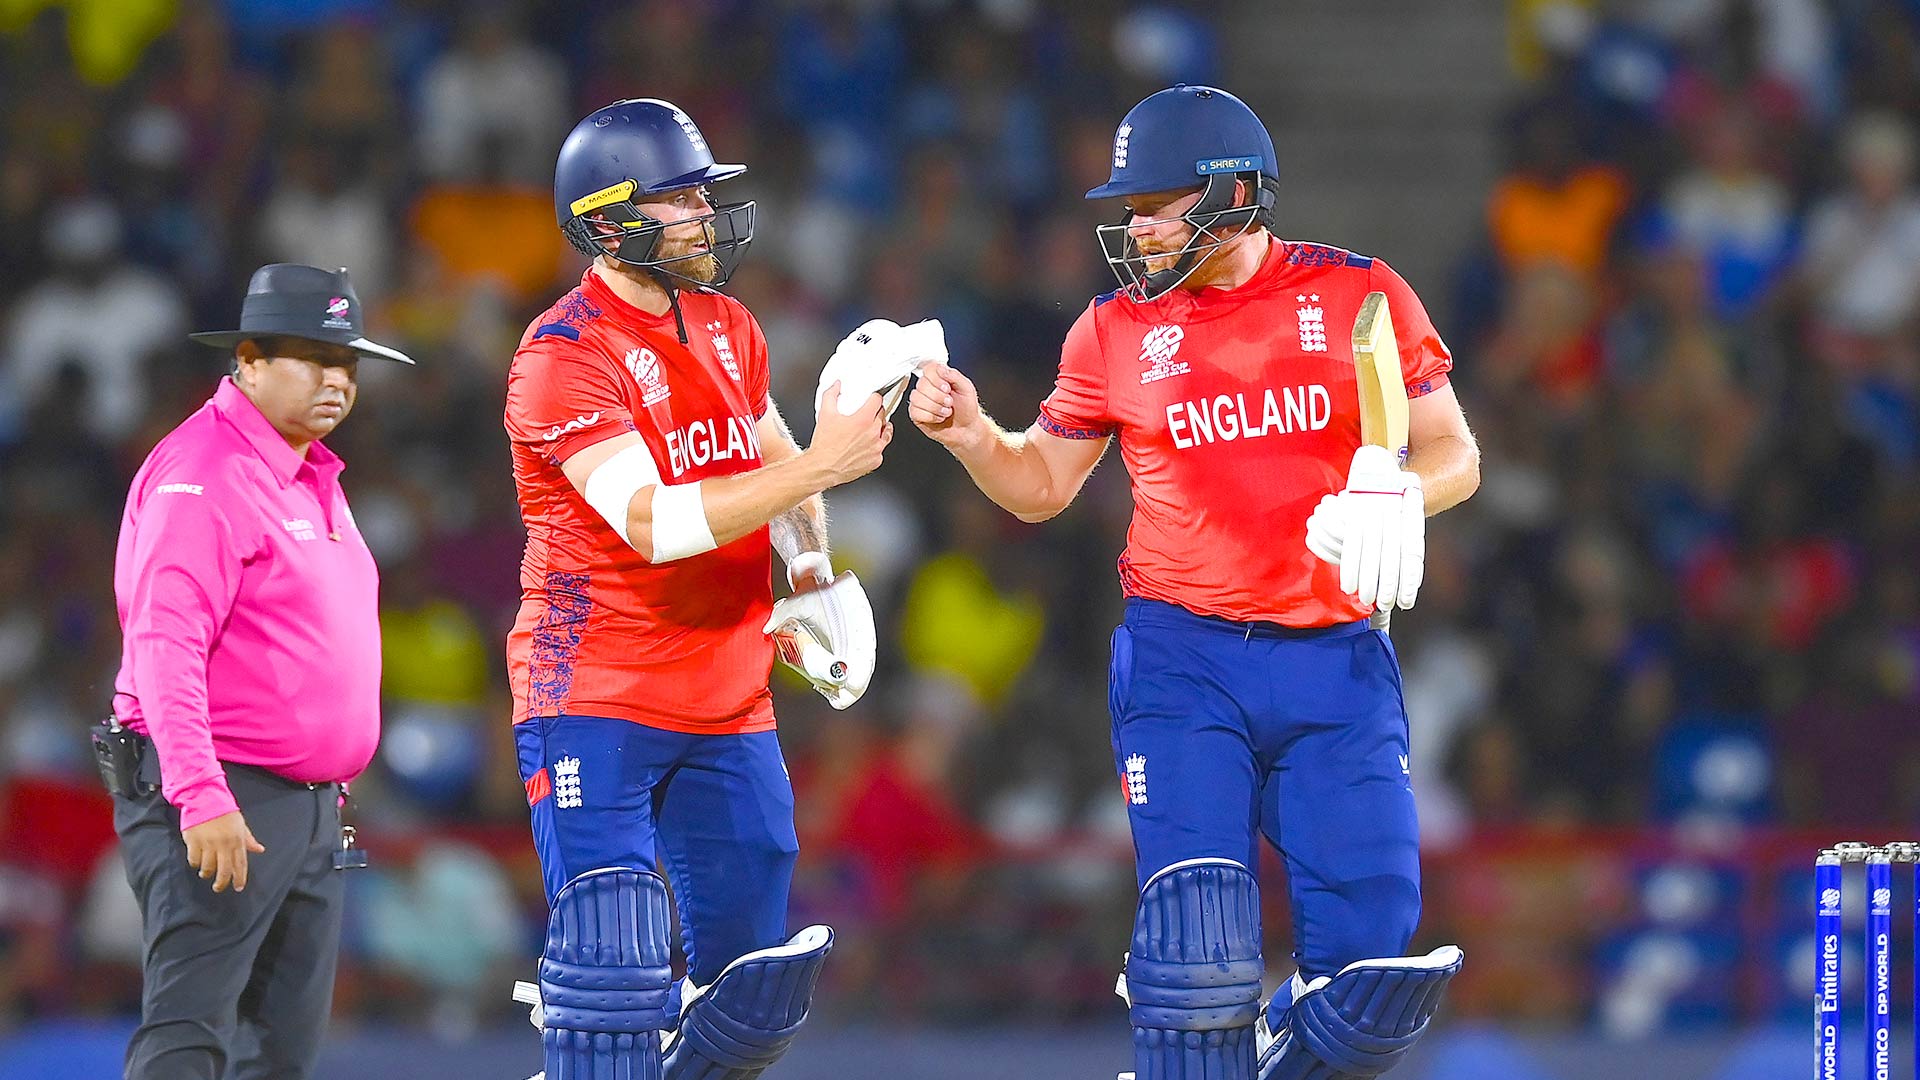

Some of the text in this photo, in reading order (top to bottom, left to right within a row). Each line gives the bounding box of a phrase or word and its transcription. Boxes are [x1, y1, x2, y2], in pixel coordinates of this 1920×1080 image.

[1210, 160, 1240, 170] SHREY
[588, 188, 622, 203] MASURI
[857, 333, 872, 344] ON
[1141, 366, 1170, 380] WORLD
[1170, 361, 1189, 372] CUP
[642, 388, 661, 402] WORLD
[1166, 384, 1331, 449] ENGLAND
[665, 414, 762, 478] ENGLAN
[157, 483, 204, 496] TRENZ
[1822, 934, 1837, 1012] Emirates
[1878, 933, 1888, 1014] DP WORLD
[1824, 1025, 1836, 1080] WORLD
